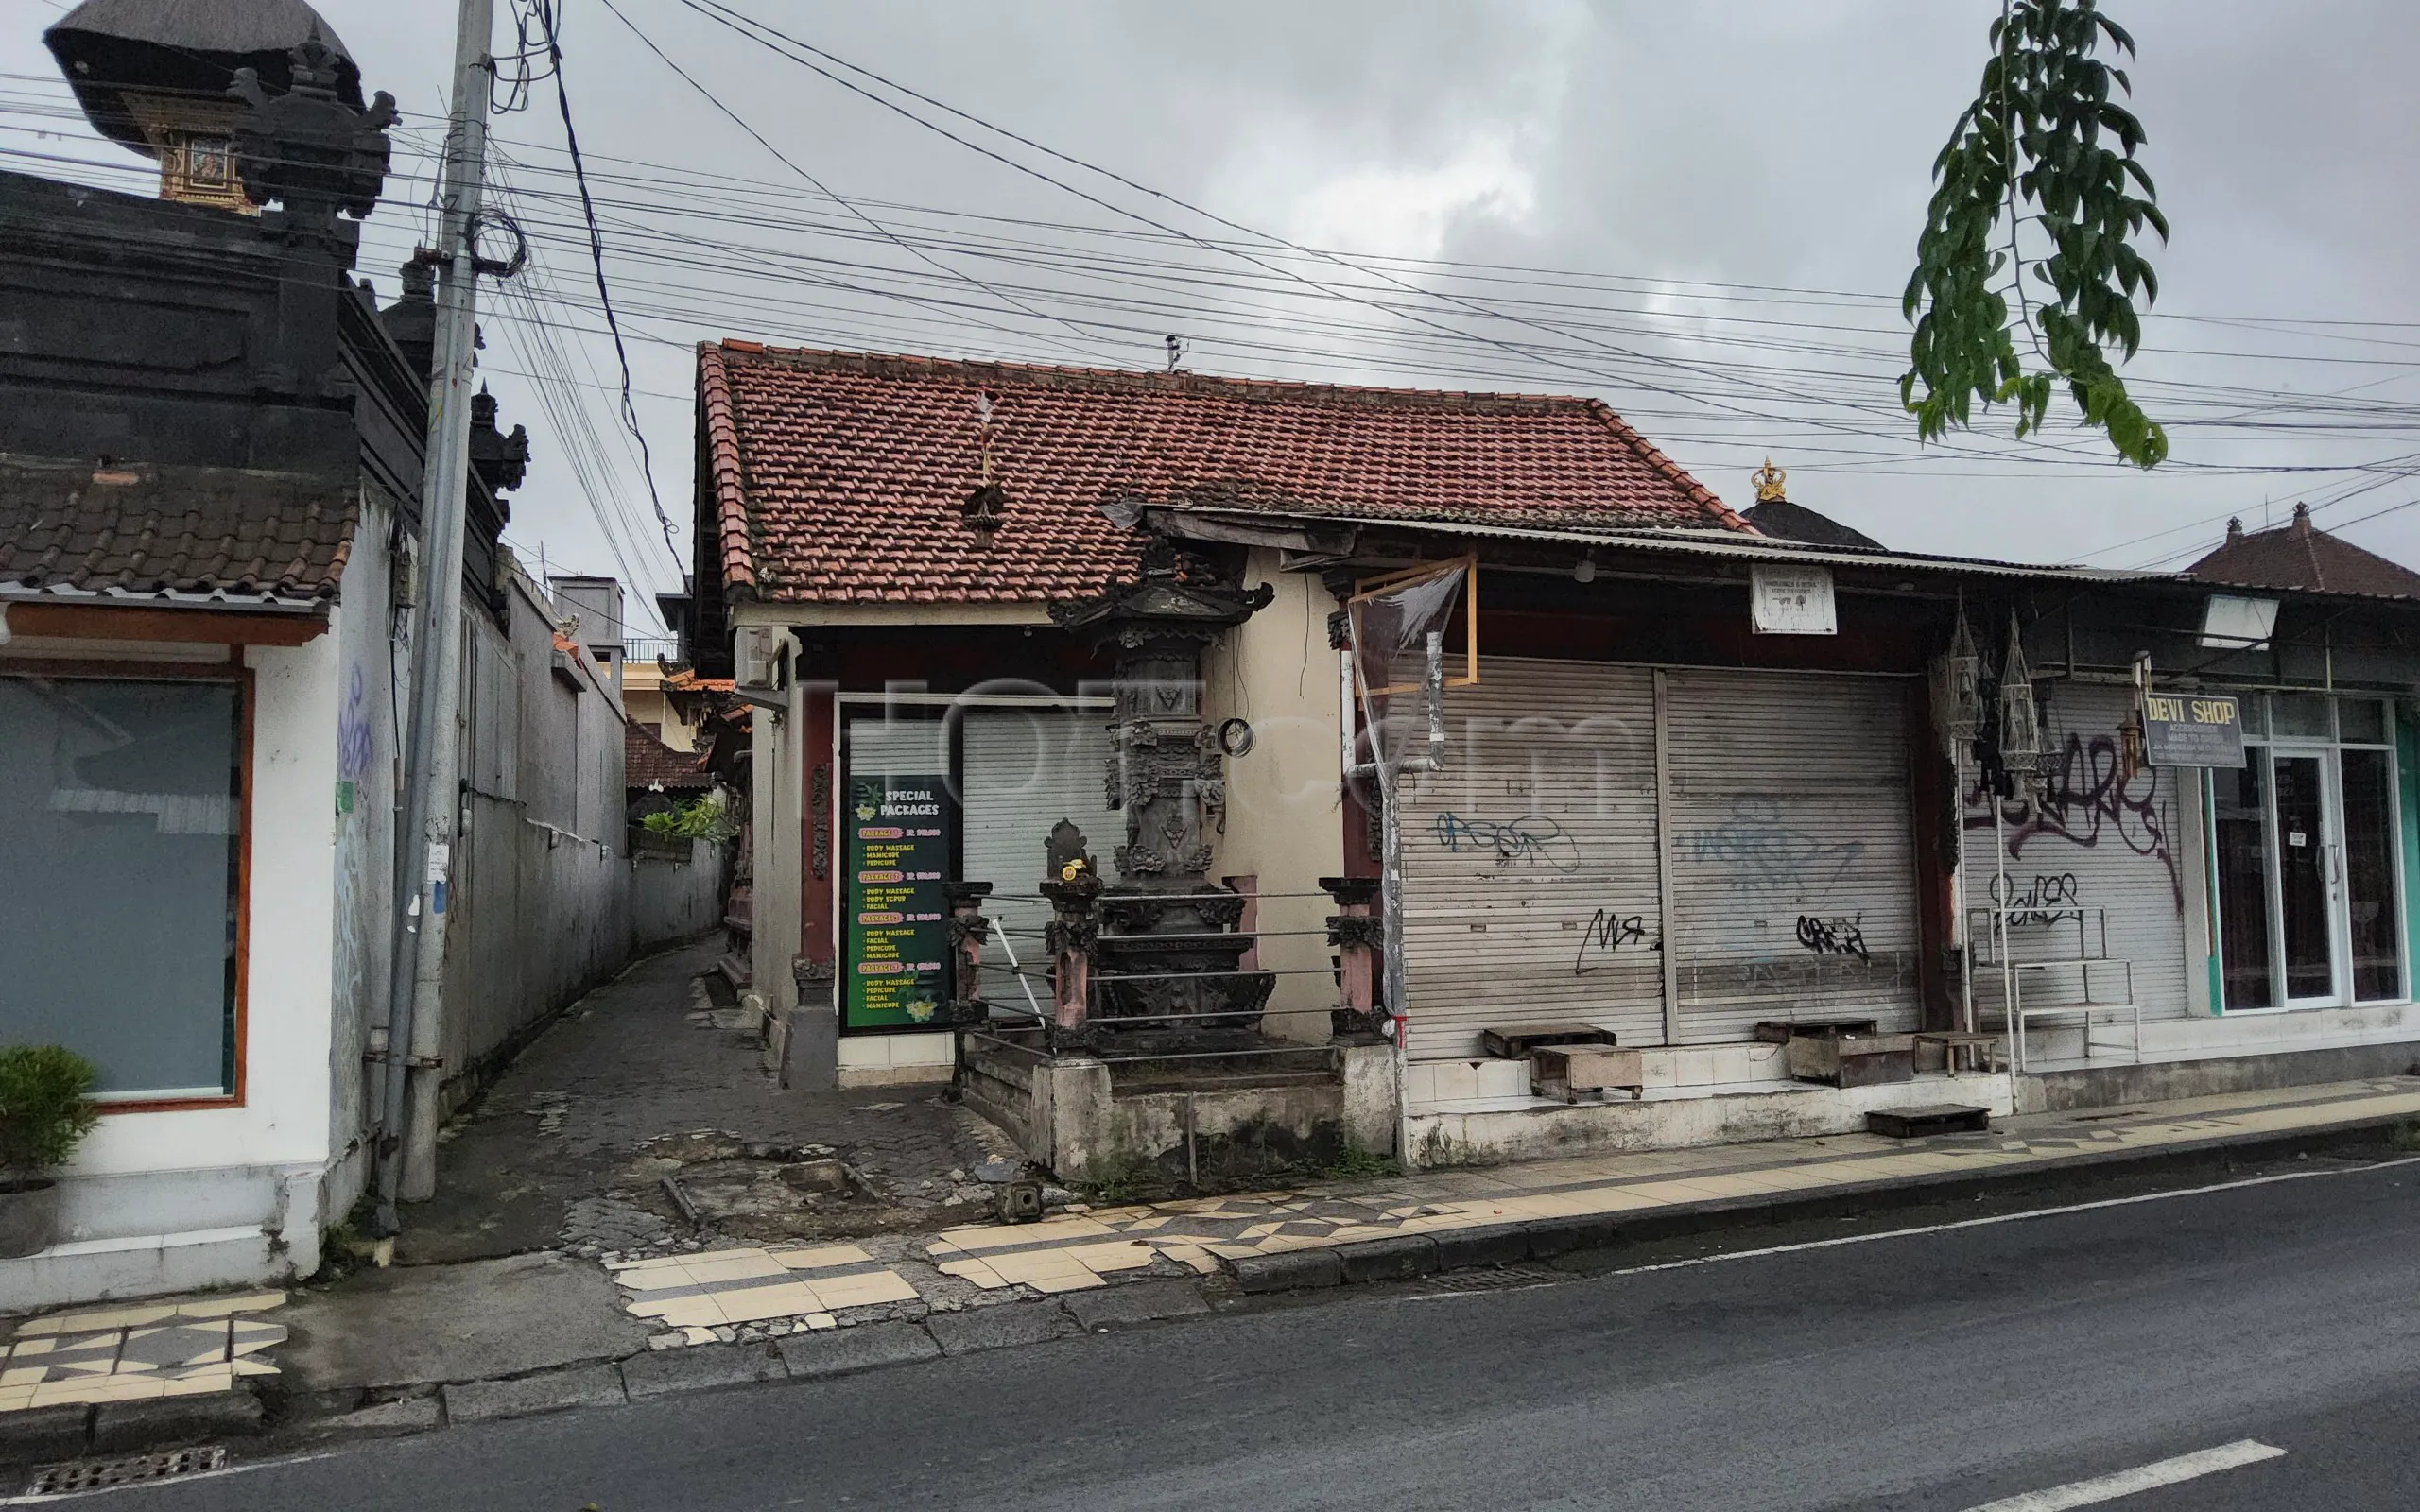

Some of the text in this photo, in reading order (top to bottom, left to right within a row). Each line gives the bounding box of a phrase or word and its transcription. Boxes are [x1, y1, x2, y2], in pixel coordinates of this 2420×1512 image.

[2148, 698, 2235, 725] DEVI SHOP
[886, 790, 934, 801] SPECIAL
[880, 804, 940, 816] PACKAGES
[862, 964, 891, 972] PACKAGE
